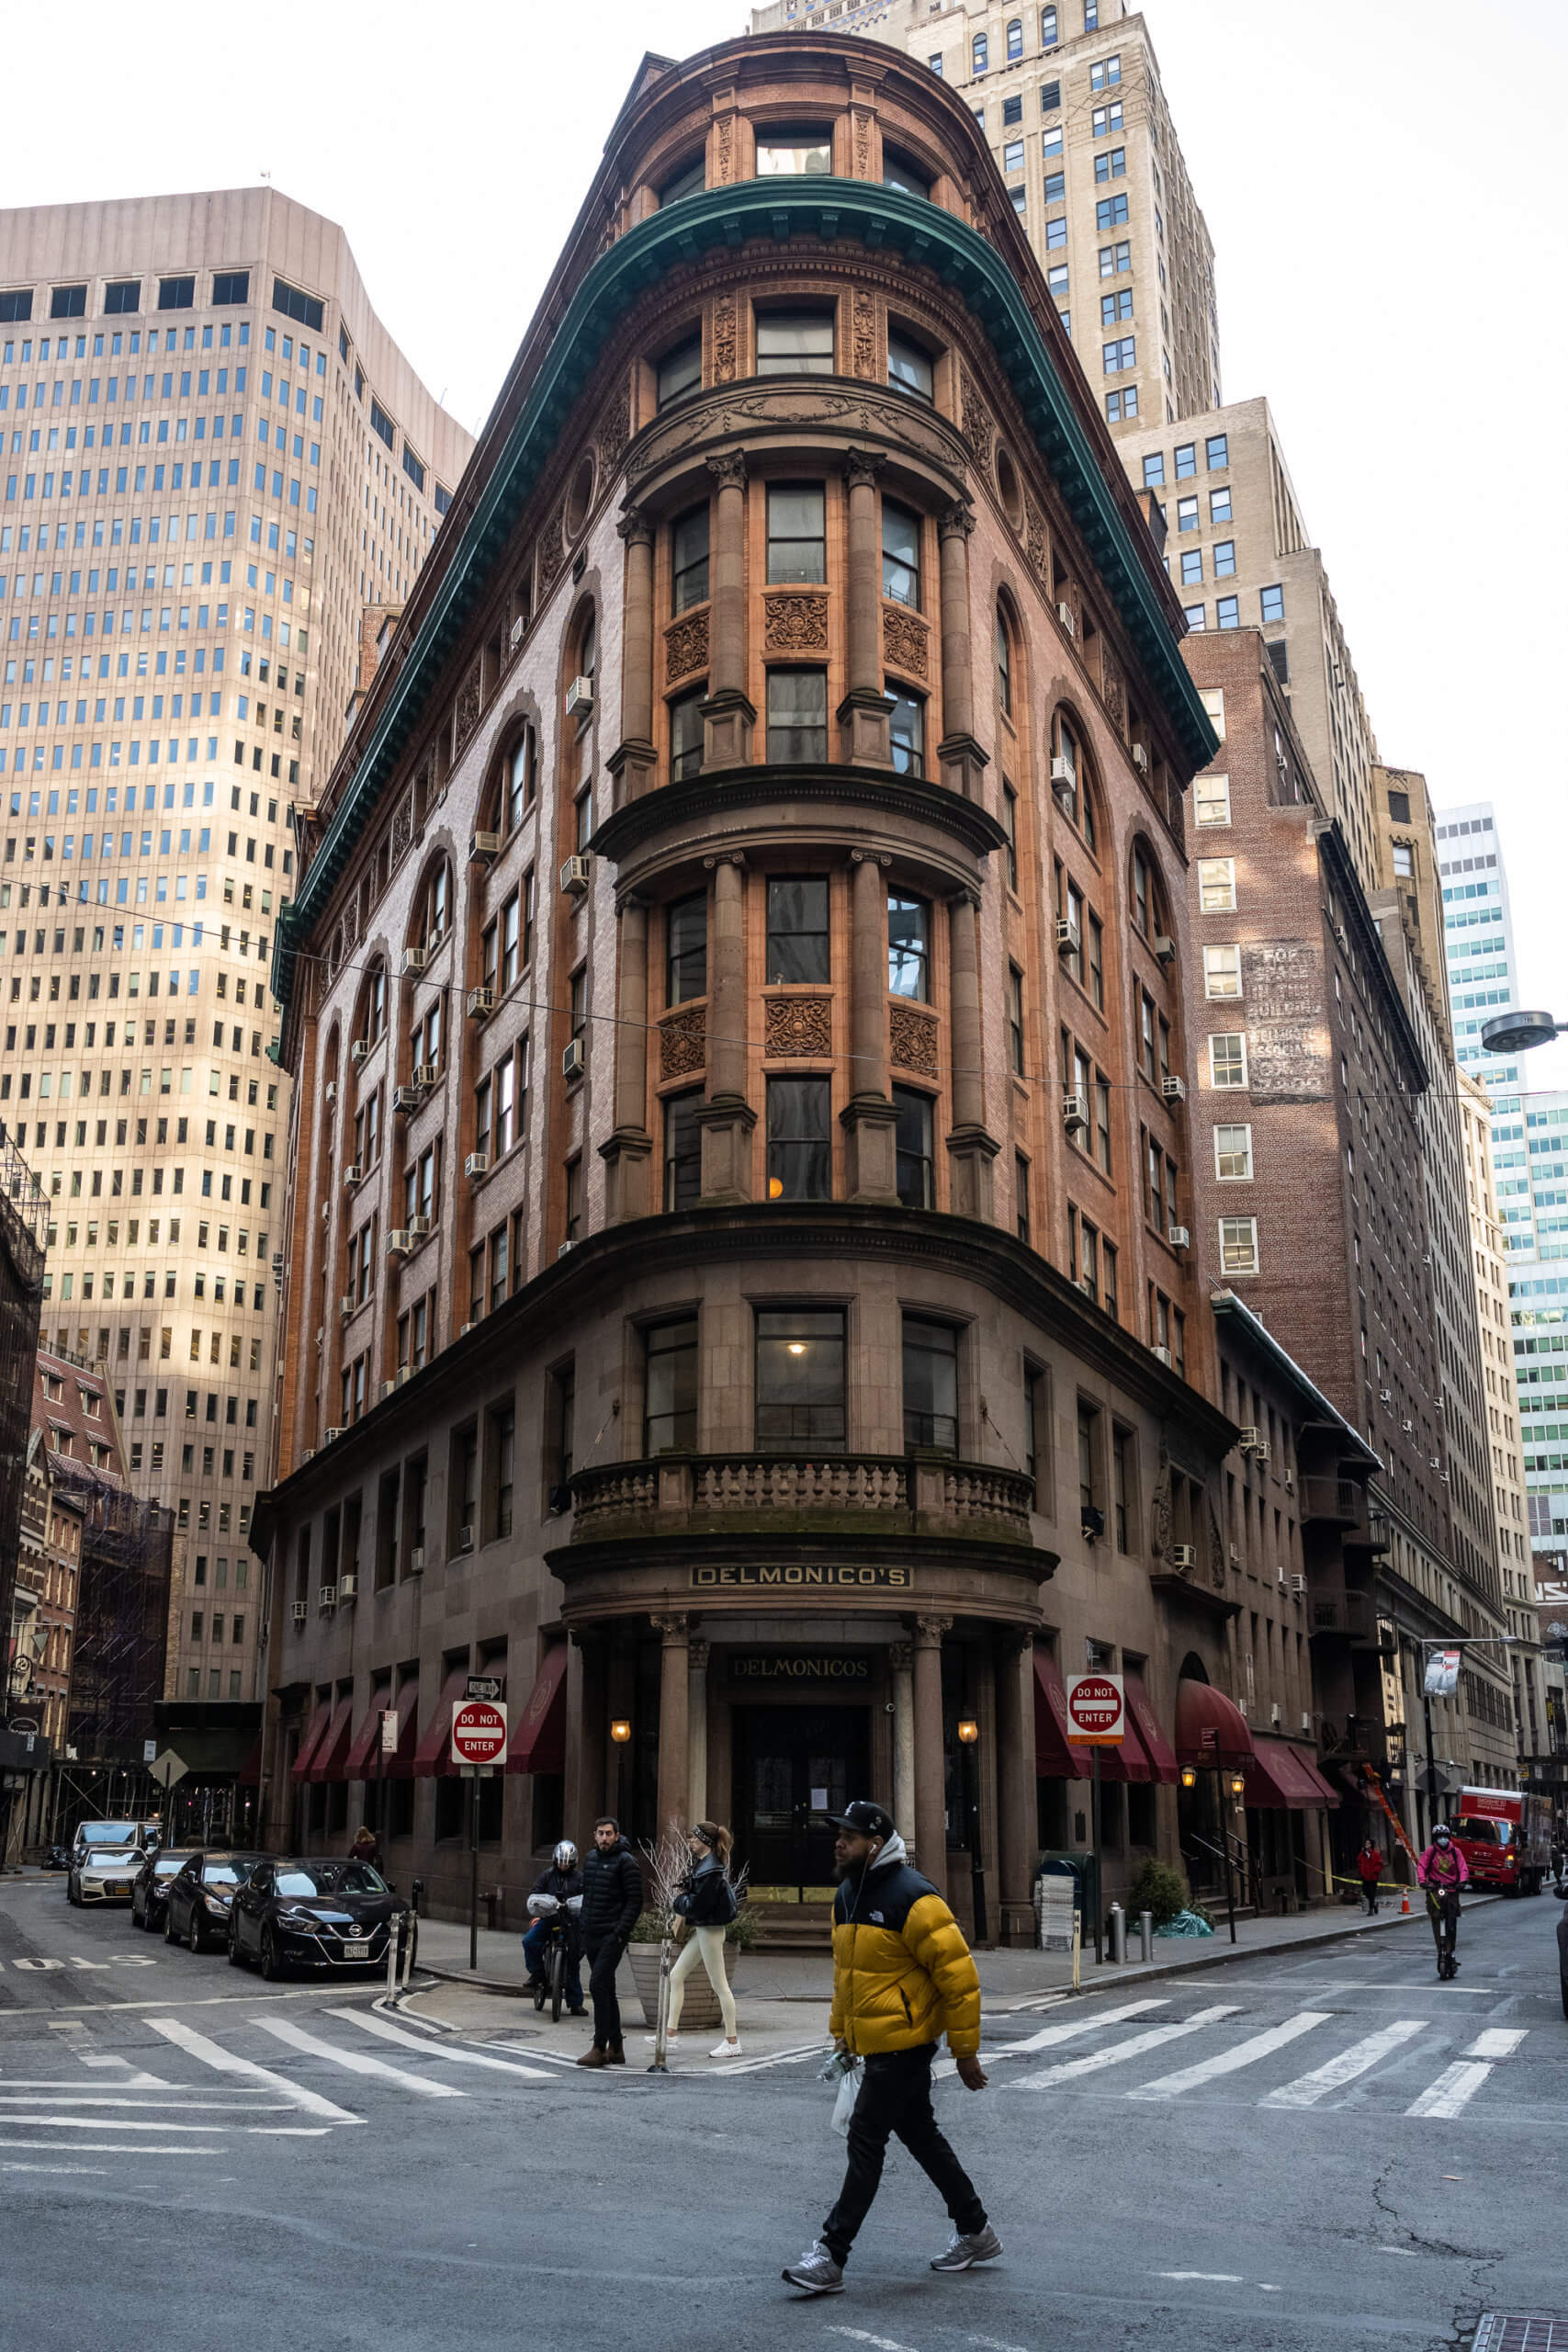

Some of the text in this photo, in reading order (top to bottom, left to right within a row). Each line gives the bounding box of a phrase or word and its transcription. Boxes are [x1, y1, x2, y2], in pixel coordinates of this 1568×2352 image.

[697, 1566, 905, 1586] DELMONICO'S
[734, 1658, 868, 1677] DELMONICOS
[471, 1682, 497, 1693] ONE WAY
[1077, 1688, 1113, 1698] DO NOT
[460, 1714, 499, 1724] DO NOT
[1078, 1713, 1113, 1723] ENTER
[464, 1741, 495, 1751] ENTER
